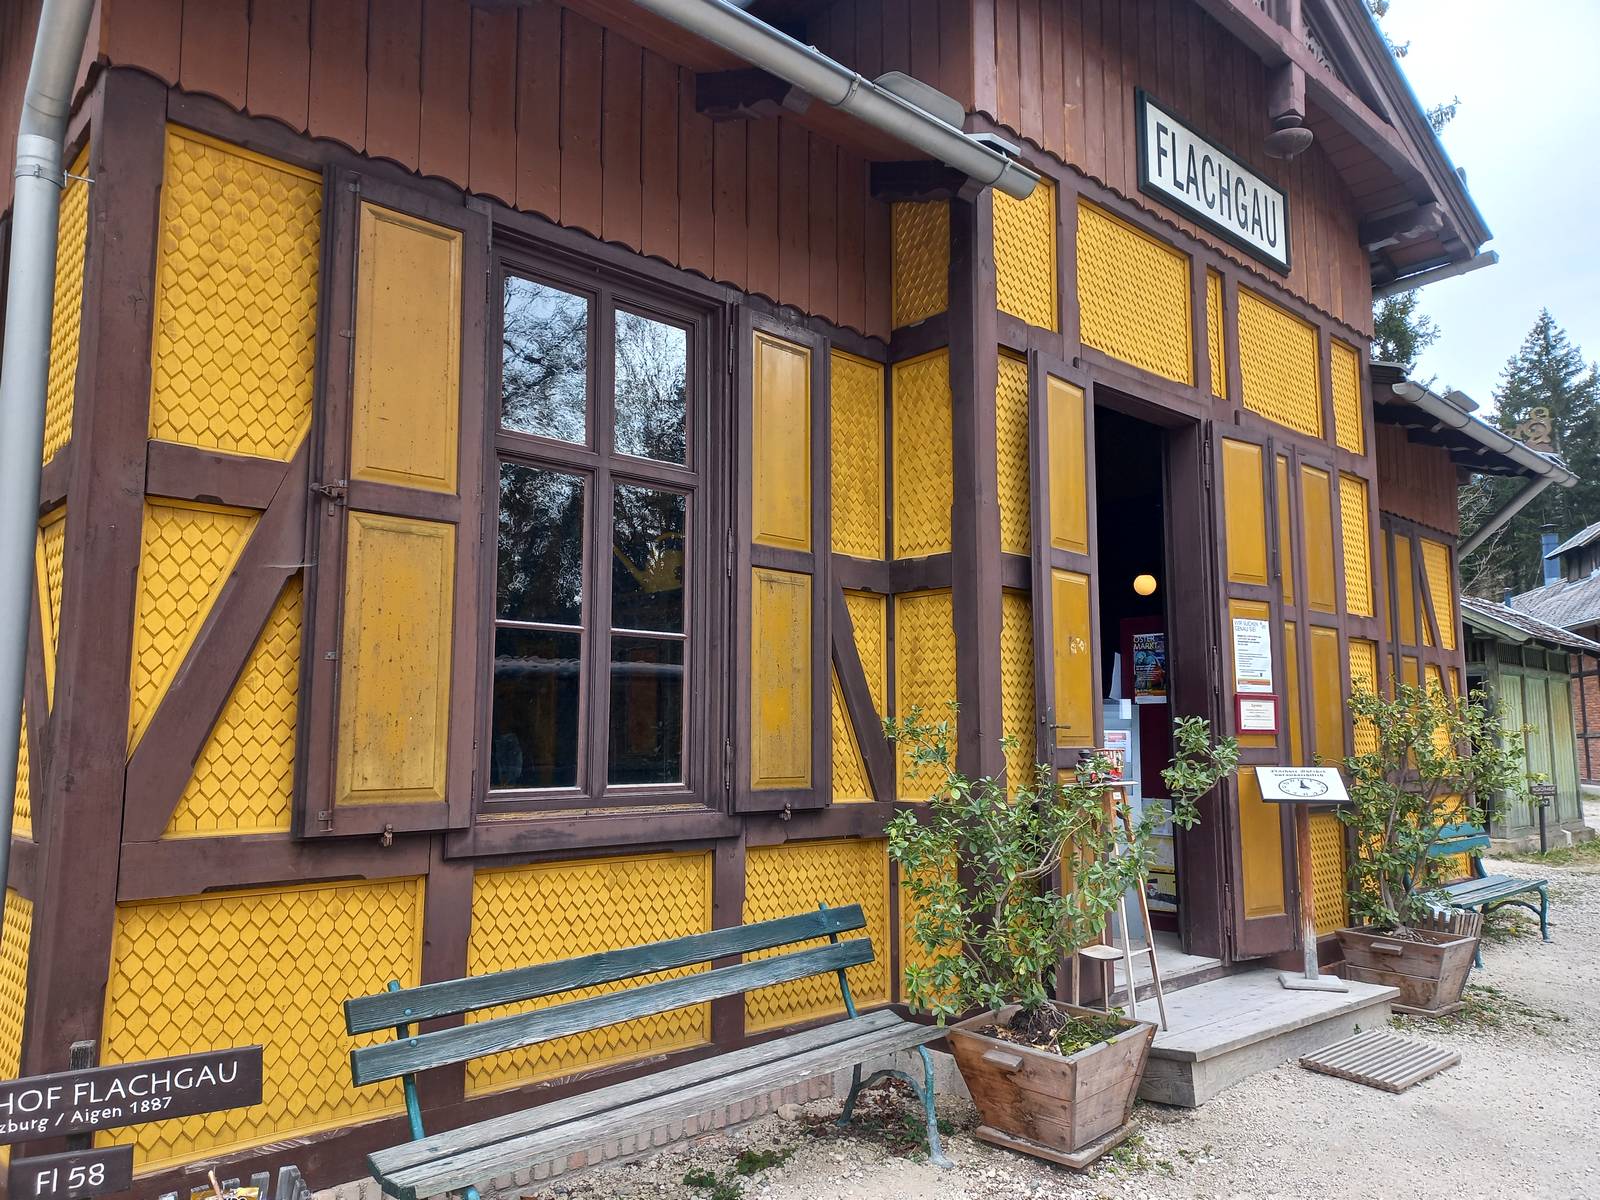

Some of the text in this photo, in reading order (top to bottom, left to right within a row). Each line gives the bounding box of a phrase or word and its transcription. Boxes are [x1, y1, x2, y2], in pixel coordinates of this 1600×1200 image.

[1156, 121, 1277, 248] FLACHGAU
[73, 1060, 239, 1106] FLACHGAU
[71, 1106, 122, 1124] Aigen
[129, 1096, 172, 1114] 1887
[68, 1163, 105, 1189] 58
